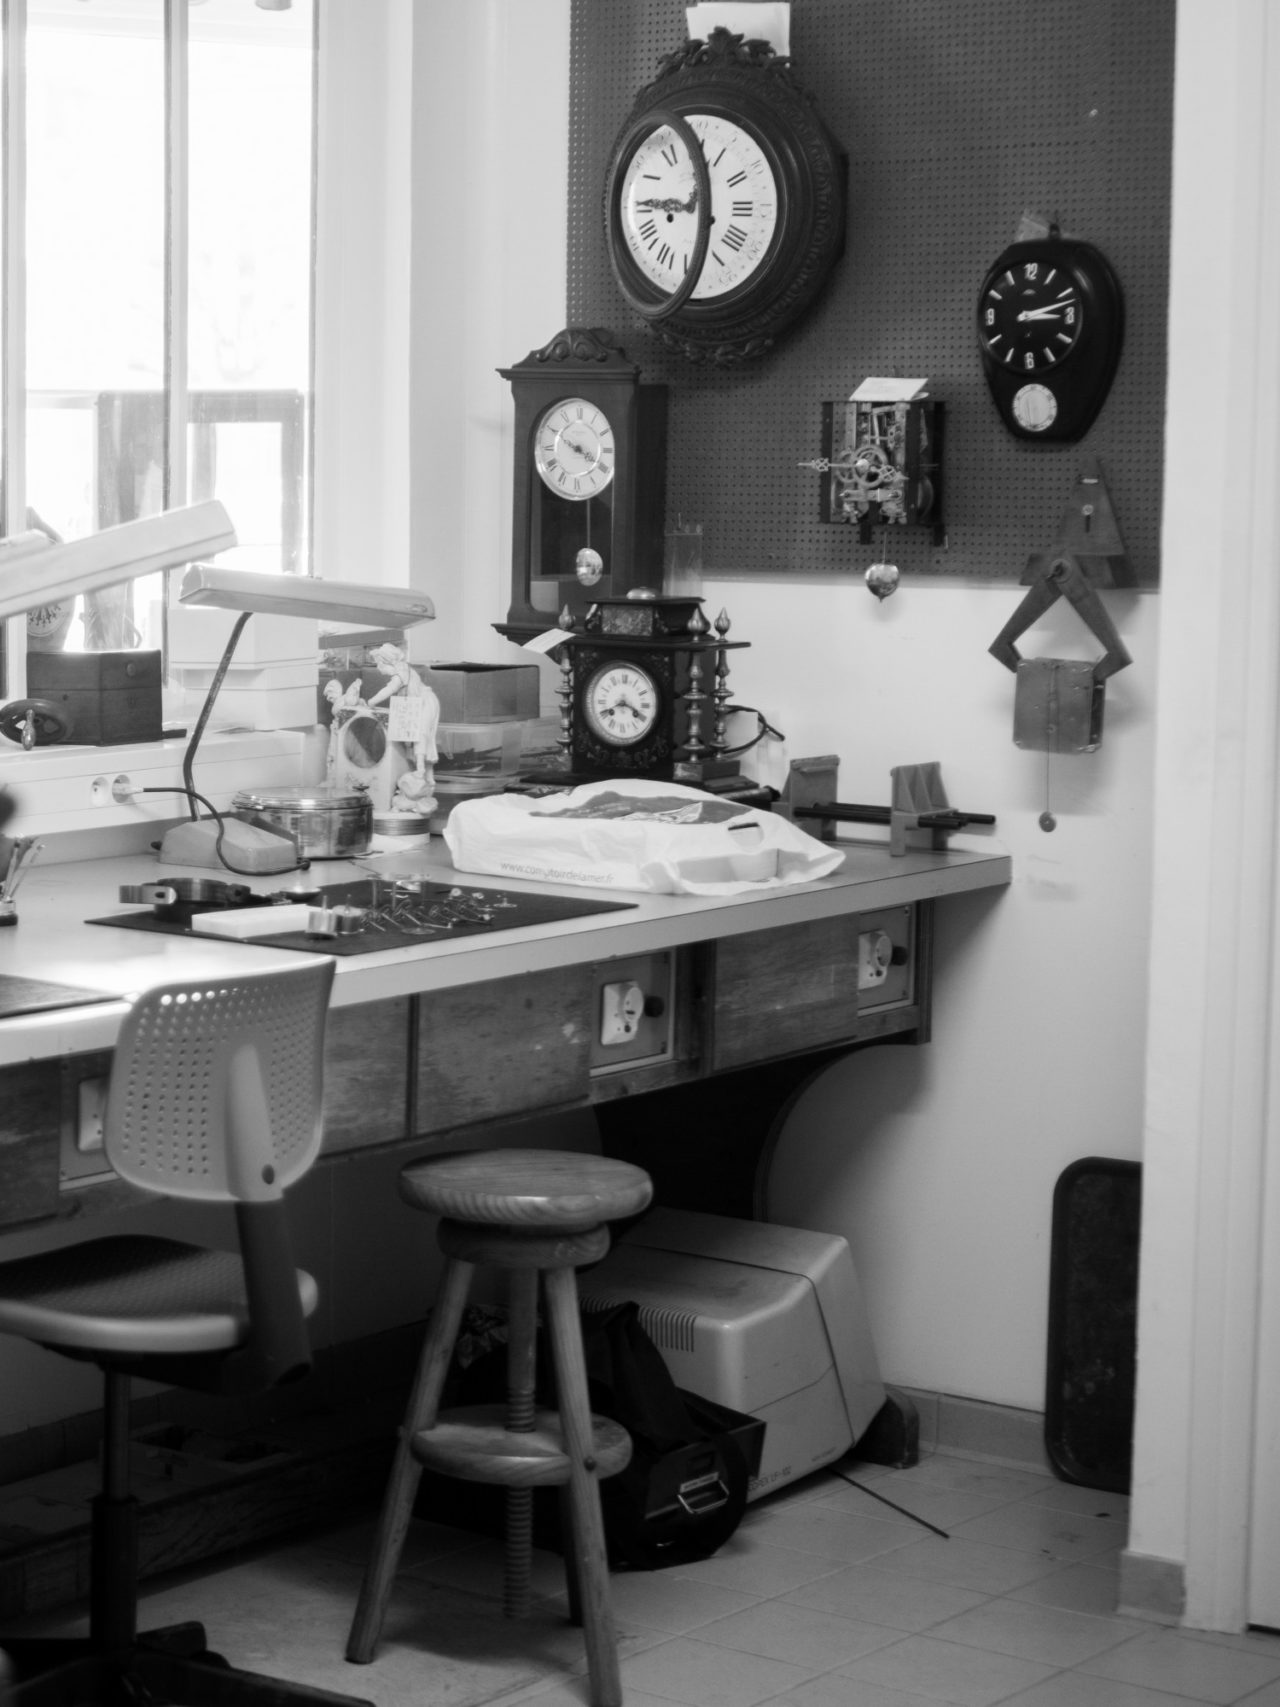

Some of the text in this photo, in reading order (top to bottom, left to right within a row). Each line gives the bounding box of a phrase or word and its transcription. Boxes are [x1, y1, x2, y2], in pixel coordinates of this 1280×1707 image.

[1024, 263, 1038, 280] 12
[985, 308, 995, 325] 9
[1024, 352, 1034, 369] 6
